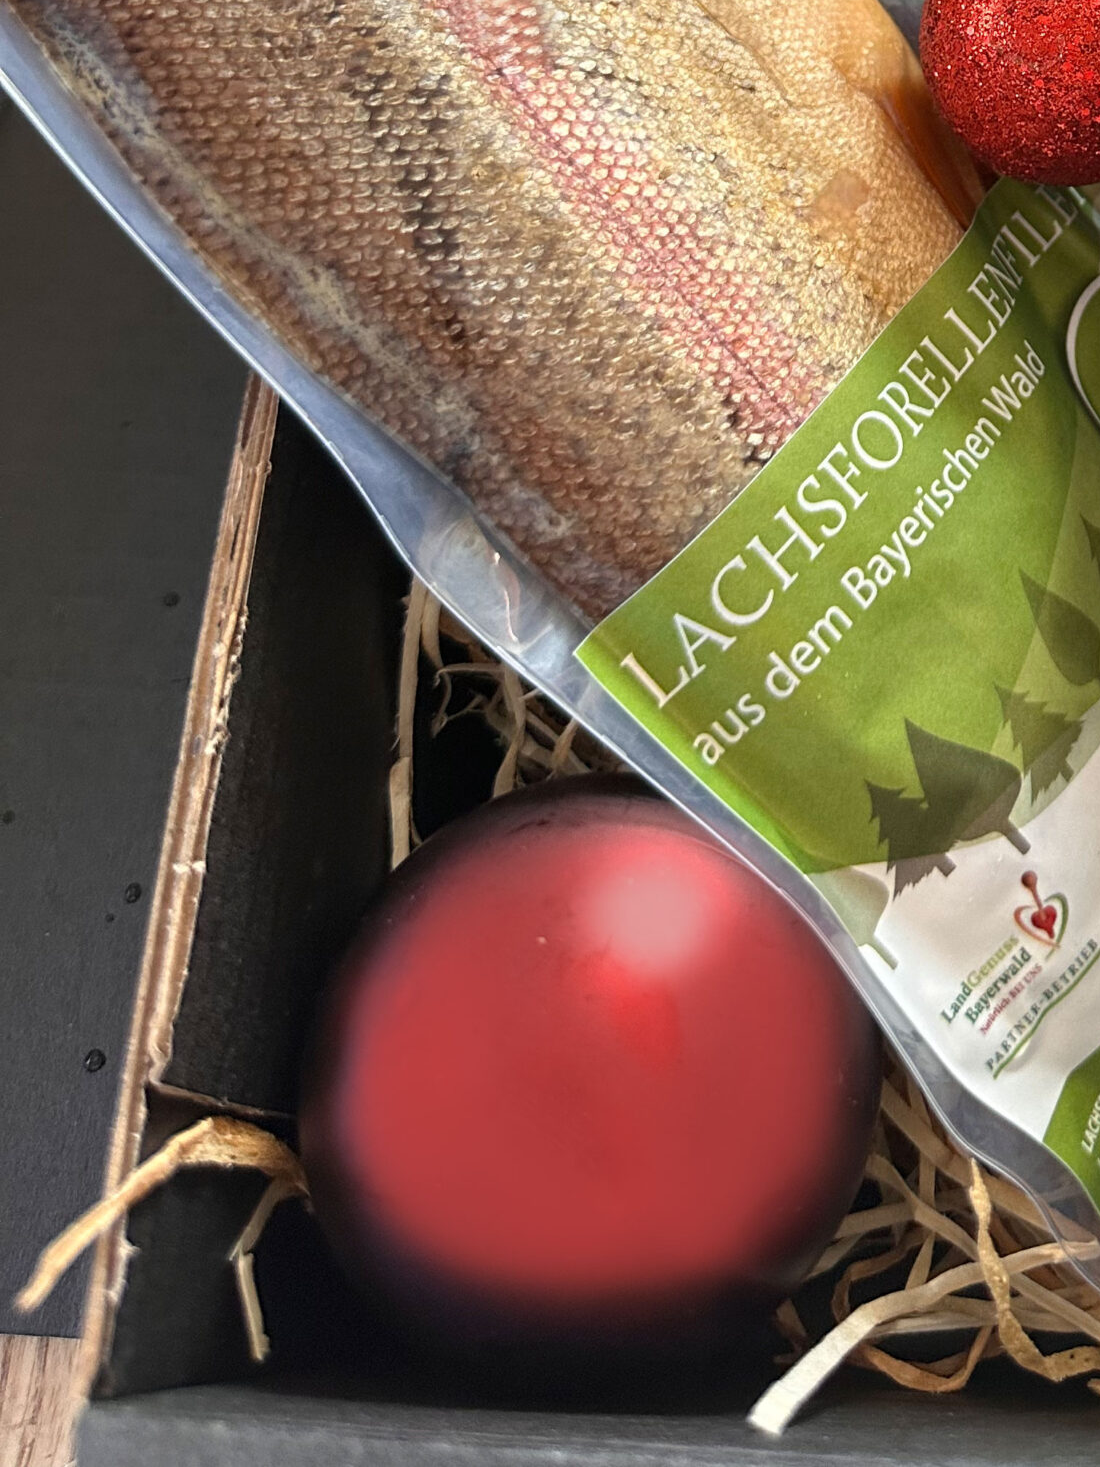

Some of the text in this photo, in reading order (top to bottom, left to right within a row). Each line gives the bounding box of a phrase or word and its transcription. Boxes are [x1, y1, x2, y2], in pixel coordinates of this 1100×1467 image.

[691, 340, 1048, 767] aus dem Bayerischen Wald
[940, 934, 1020, 1025] LandGenuss
[964, 945, 1033, 1025] Bayerwald
[985, 938, 1099, 1071] PARTNER-BETRIEB
[1023, 962, 1044, 986] UNS
